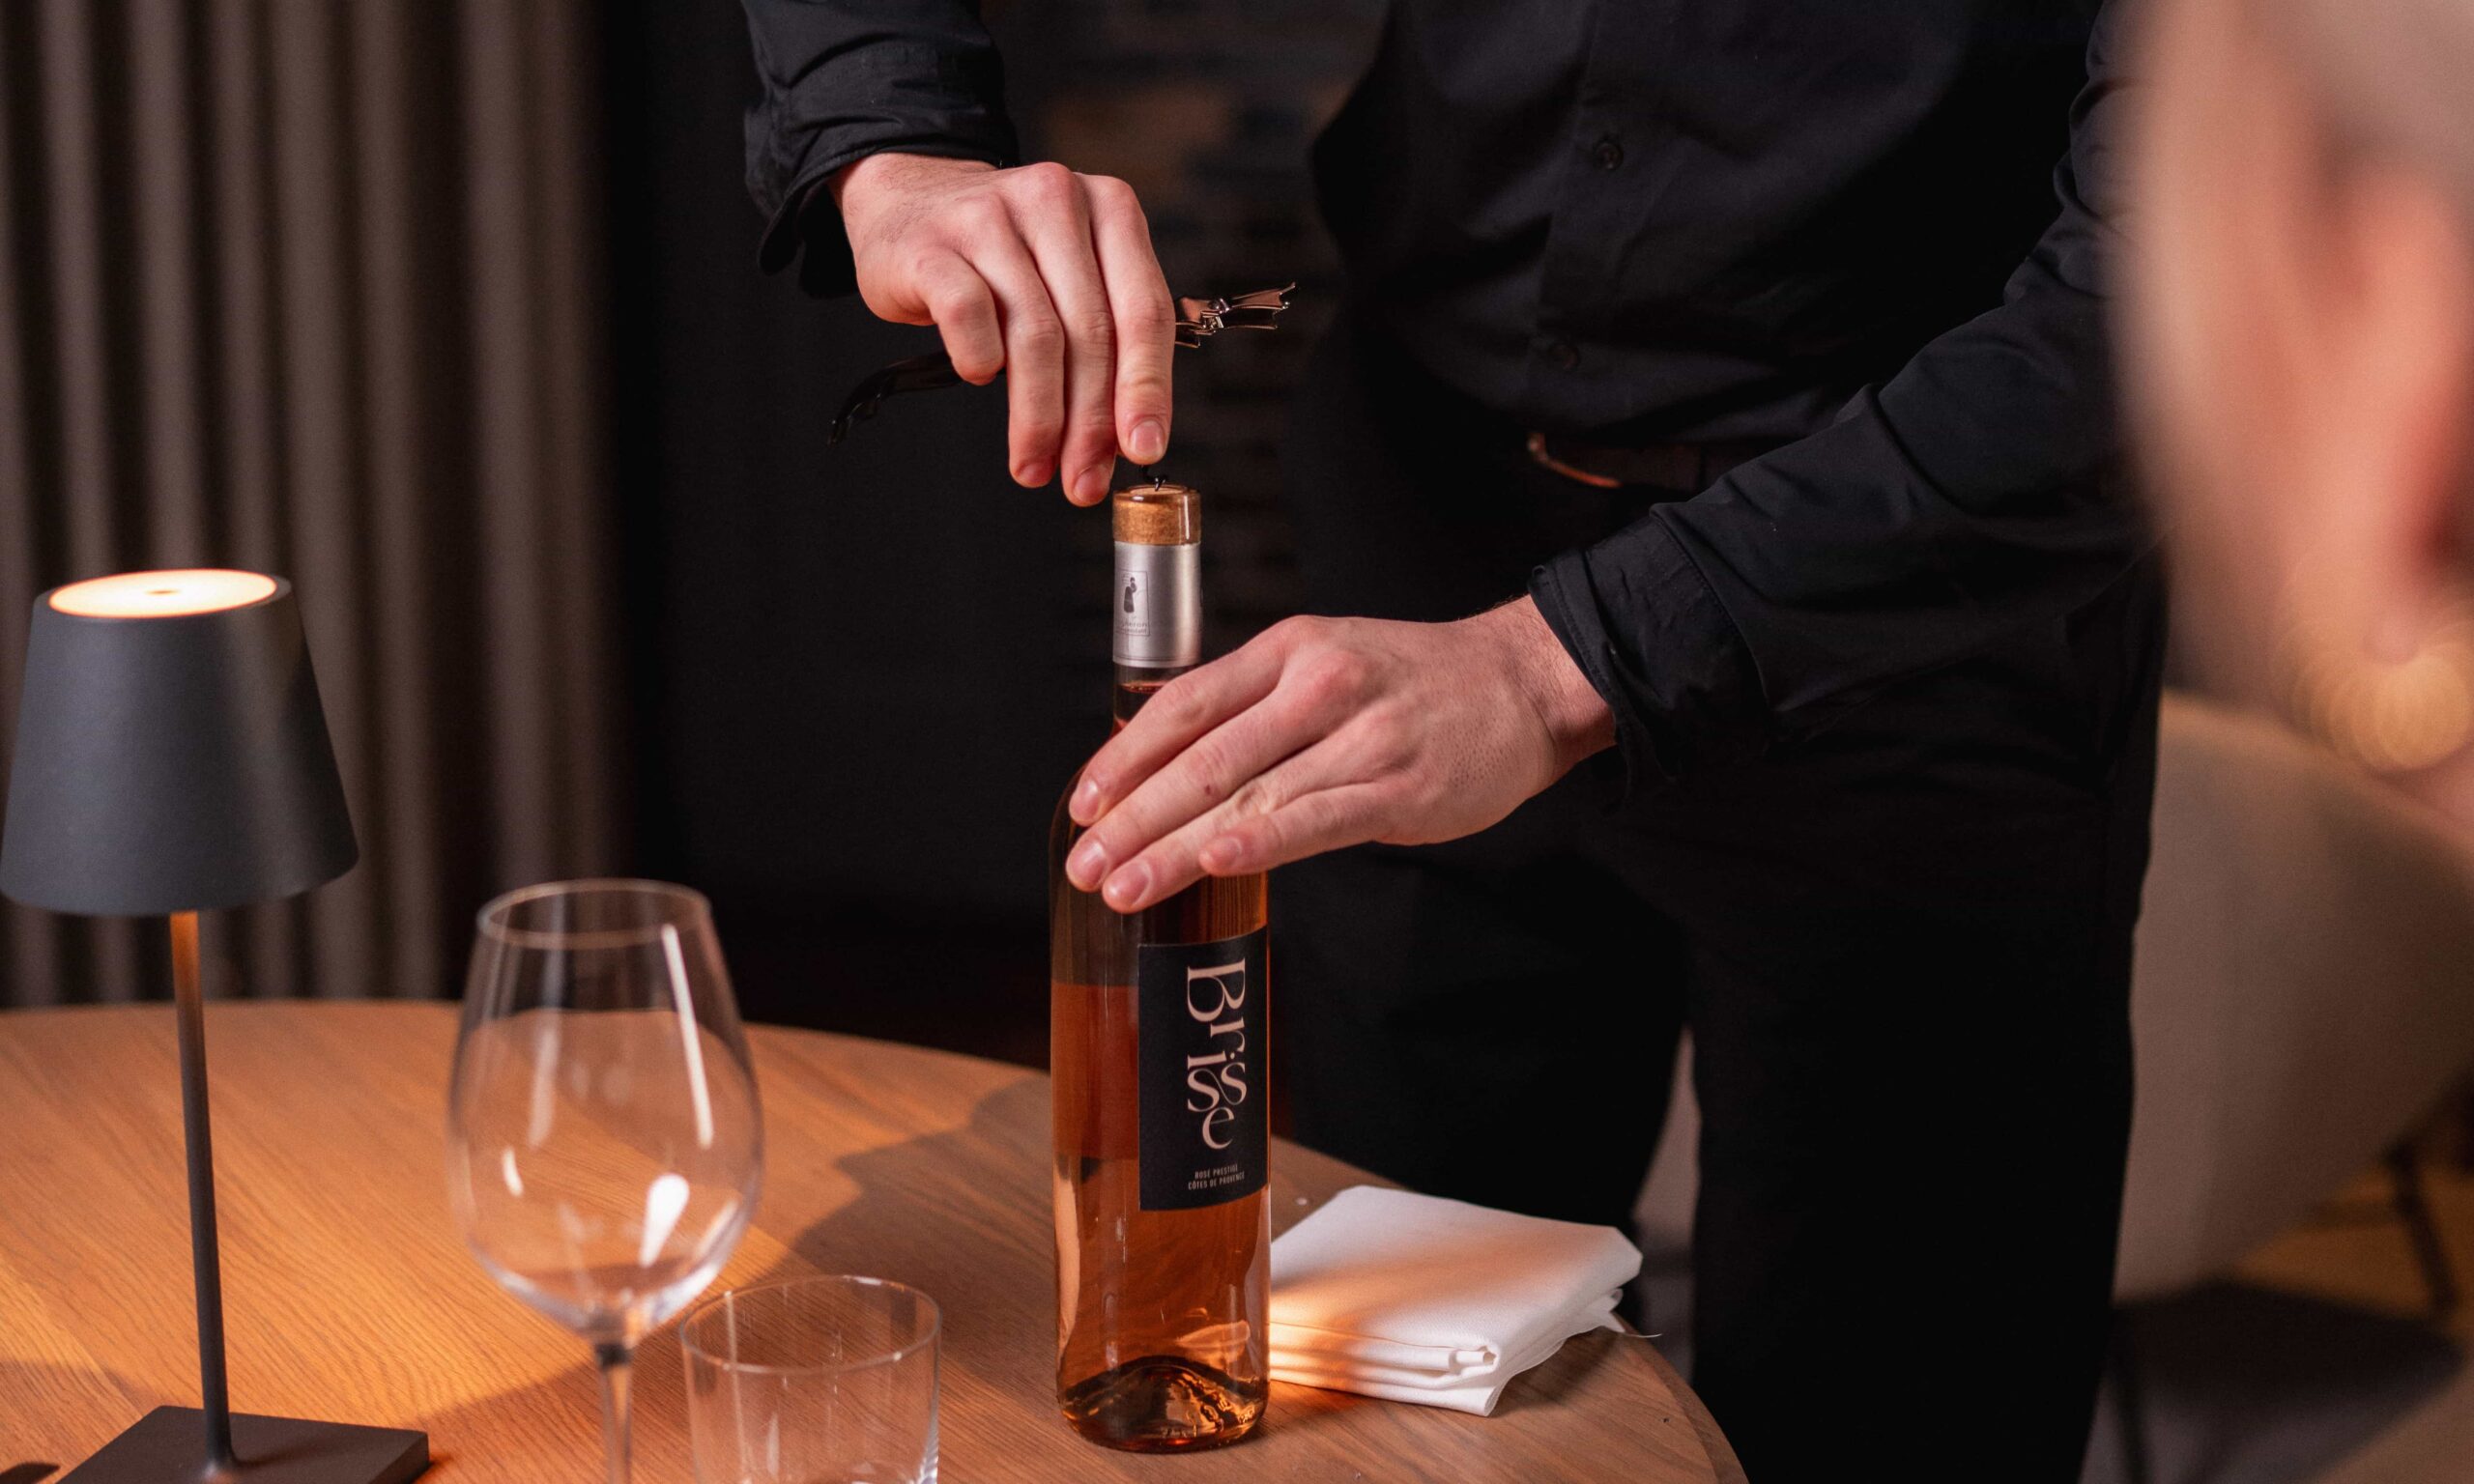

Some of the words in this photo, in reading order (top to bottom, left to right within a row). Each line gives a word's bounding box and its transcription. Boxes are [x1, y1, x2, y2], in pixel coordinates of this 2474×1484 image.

[1188, 1180, 1208, 1190] CÔTES
[1209, 1178, 1217, 1187] DE
[1219, 1171, 1245, 1185] PROVENCE
